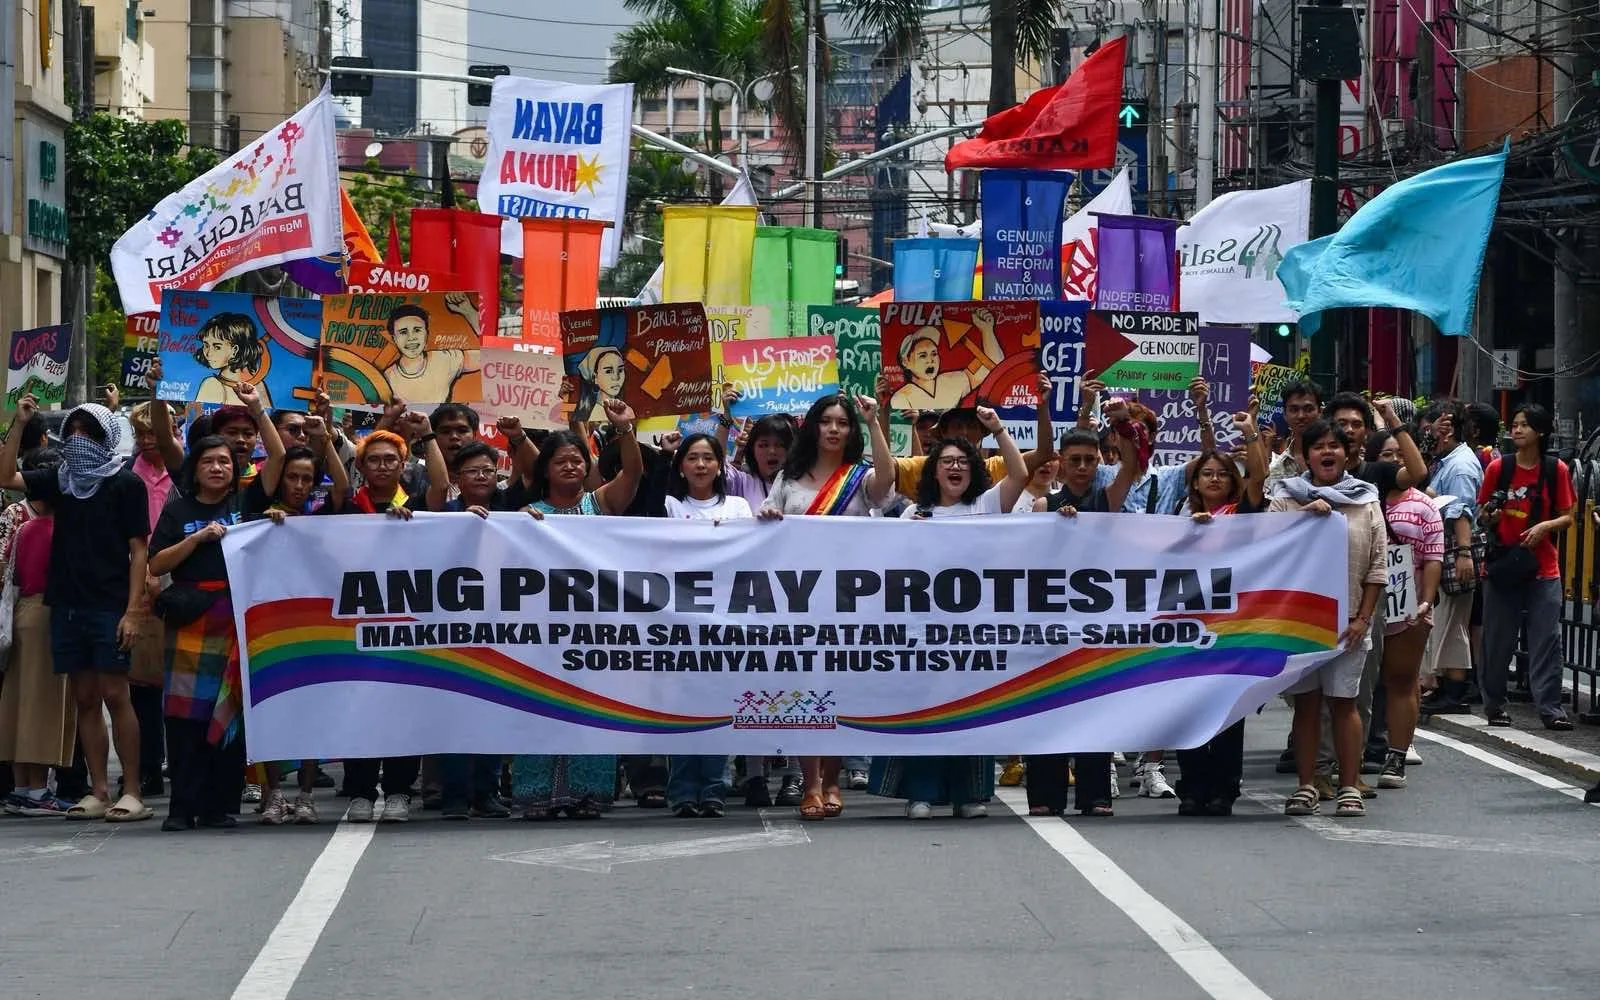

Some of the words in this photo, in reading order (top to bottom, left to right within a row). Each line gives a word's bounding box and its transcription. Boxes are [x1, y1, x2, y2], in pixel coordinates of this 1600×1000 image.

[1025, 197, 1032, 206] 6
[996, 230, 1054, 243] GENUINE
[560, 251, 568, 260] 2
[1008, 244, 1044, 256] LAND
[997, 258, 1054, 270] REFORM
[1023, 271, 1032, 283] &
[884, 304, 944, 327] PULA
[1111, 314, 1136, 330] NO
[1142, 315, 1182, 333] PRIDE
[1185, 318, 1198, 333] IN
[1042, 341, 1086, 373] GET
[1140, 340, 1196, 356] GENOCIDE
[483, 361, 556, 385] CELEBRATE
[776, 368, 824, 397] NOW!
[489, 383, 553, 410] JUSTICE
[338, 567, 485, 616] ANG
[500, 569, 715, 614] PRIDE
[727, 569, 823, 614] AY
[836, 567, 1233, 614] PROTESTA!
[362, 623, 542, 648] MAKIBAKA
[549, 624, 640, 646] PARA
[647, 624, 696, 646] SA
[700, 623, 918, 649] KARAPATAN,
[925, 622, 1212, 646] DAGDAG-SAHOD,
[562, 649, 769, 672] SOBERANYA
[774, 649, 815, 672] AT
[824, 649, 1008, 672] HUSTISYA!
[734, 715, 836, 724] BAHAGHARI
